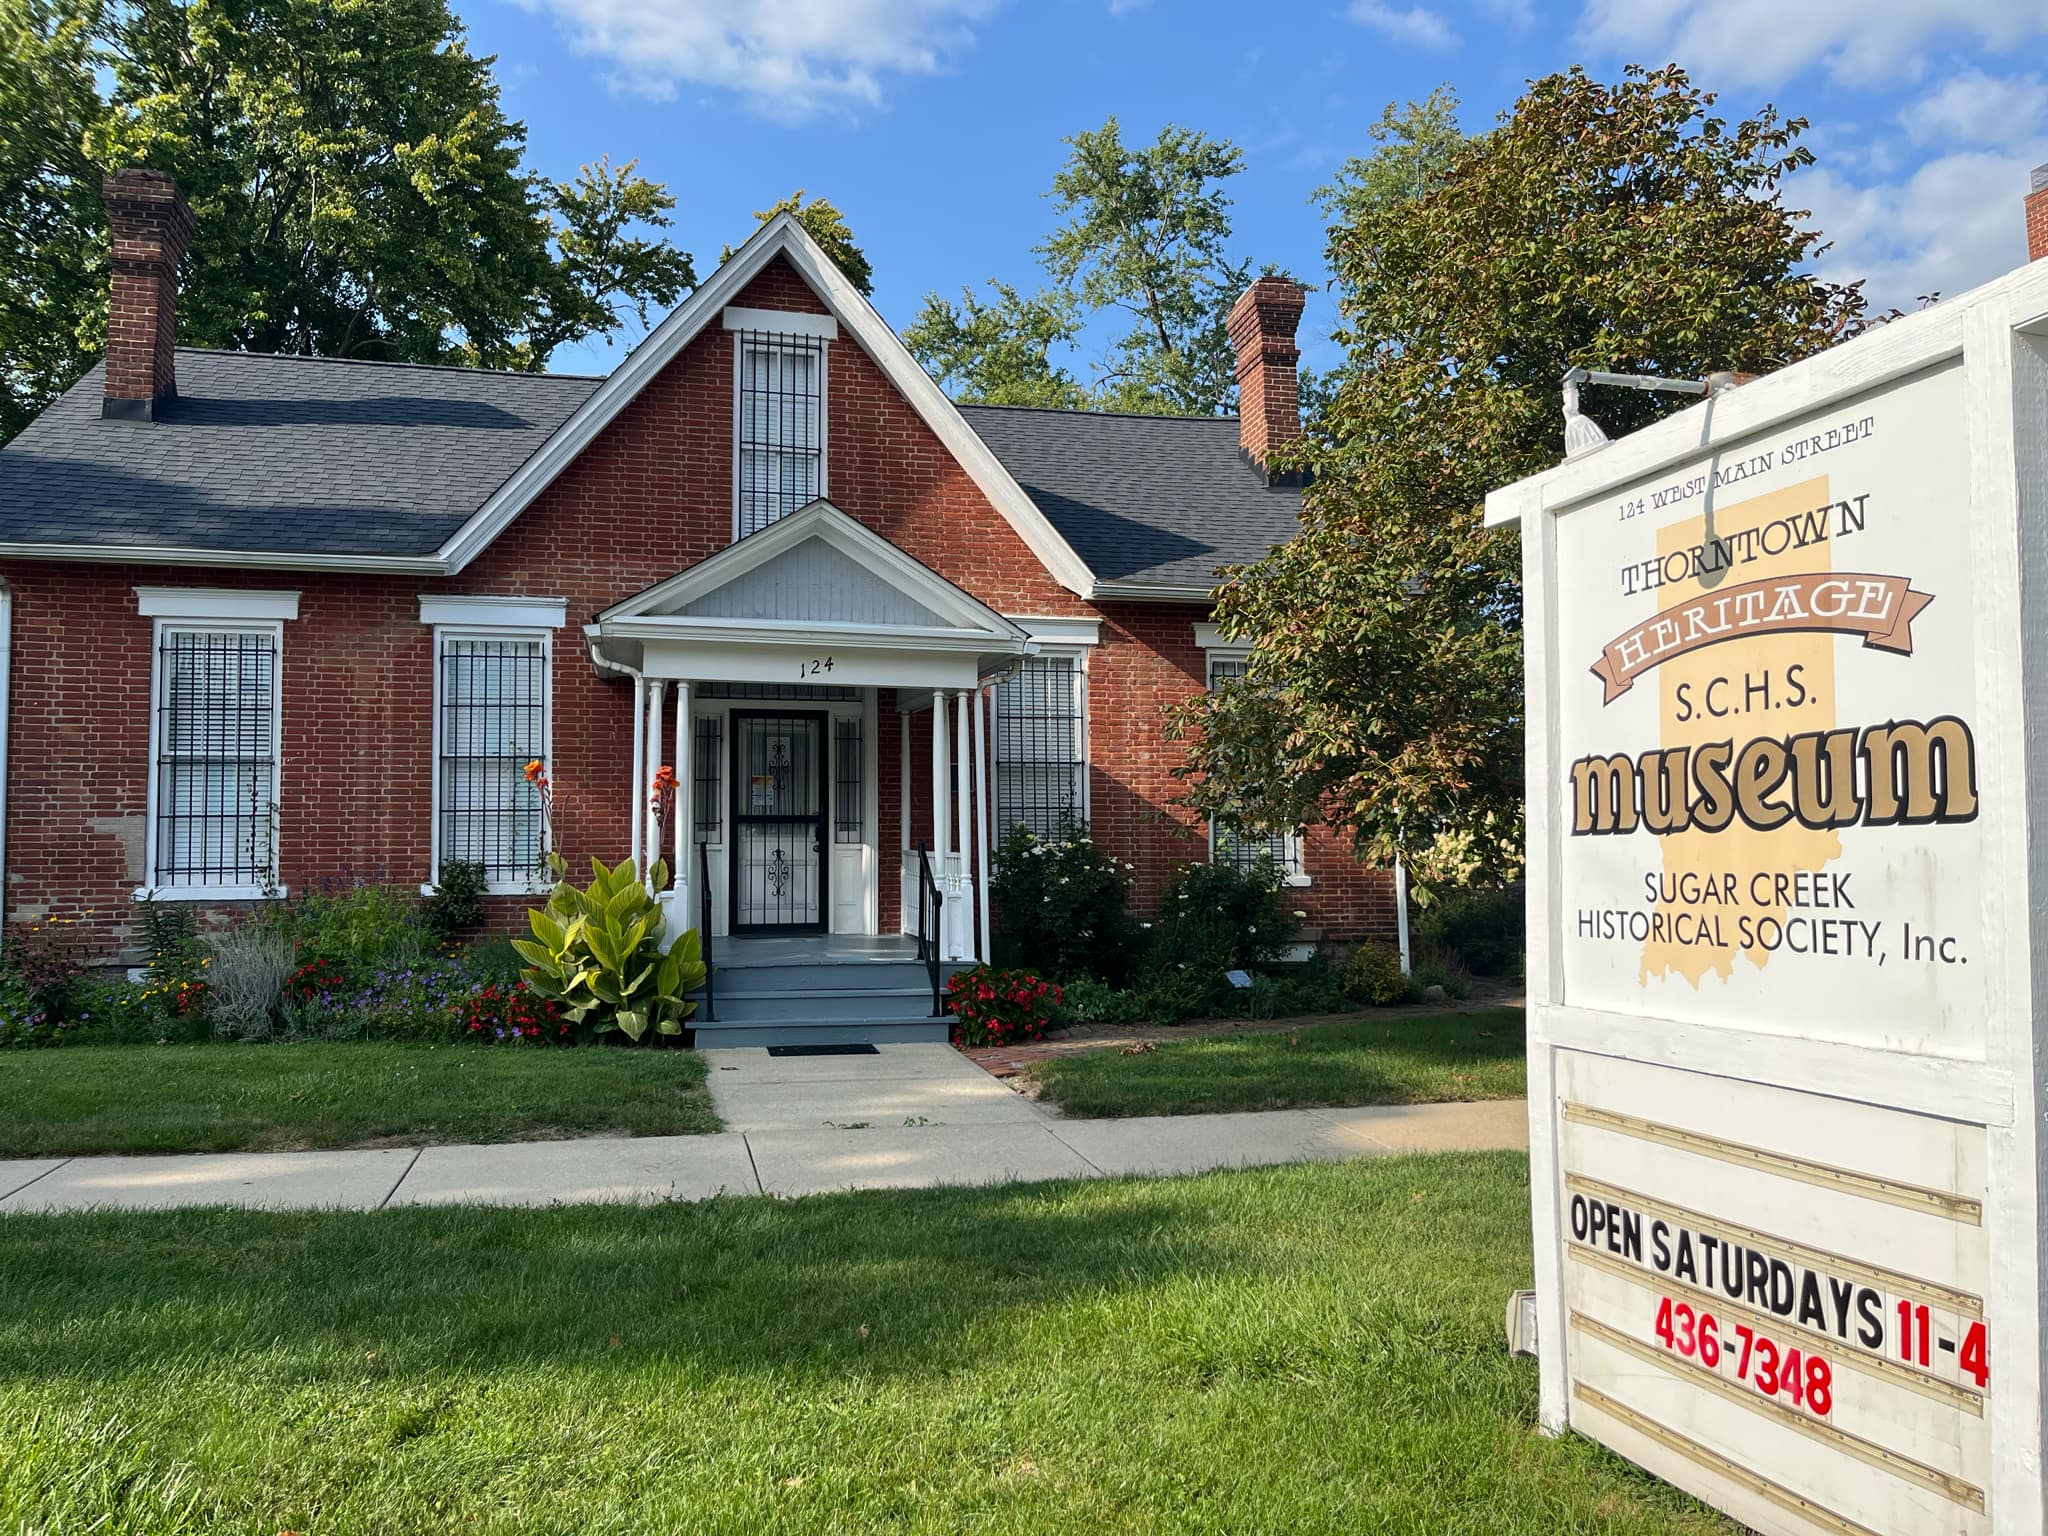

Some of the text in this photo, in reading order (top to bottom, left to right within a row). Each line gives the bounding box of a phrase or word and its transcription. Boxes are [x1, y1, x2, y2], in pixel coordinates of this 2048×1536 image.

[1618, 416, 1875, 521] 124 WEST MAIN STREET
[1621, 493, 1871, 597] THORNTOWN
[800, 656, 834, 679] 124
[1614, 580, 1893, 672] HERITAGE
[1675, 664, 1817, 721] S.C.H.S.
[1569, 714, 1979, 837] museum
[1577, 909, 1968, 967] HISTORICAL SOCIETY, Inc.
[1644, 871, 1855, 909] SUGAR CREEK
[1570, 1193, 1990, 1389] OPEN SATURDAYS 11-4
[1655, 1297, 1833, 1416] 436-7348
